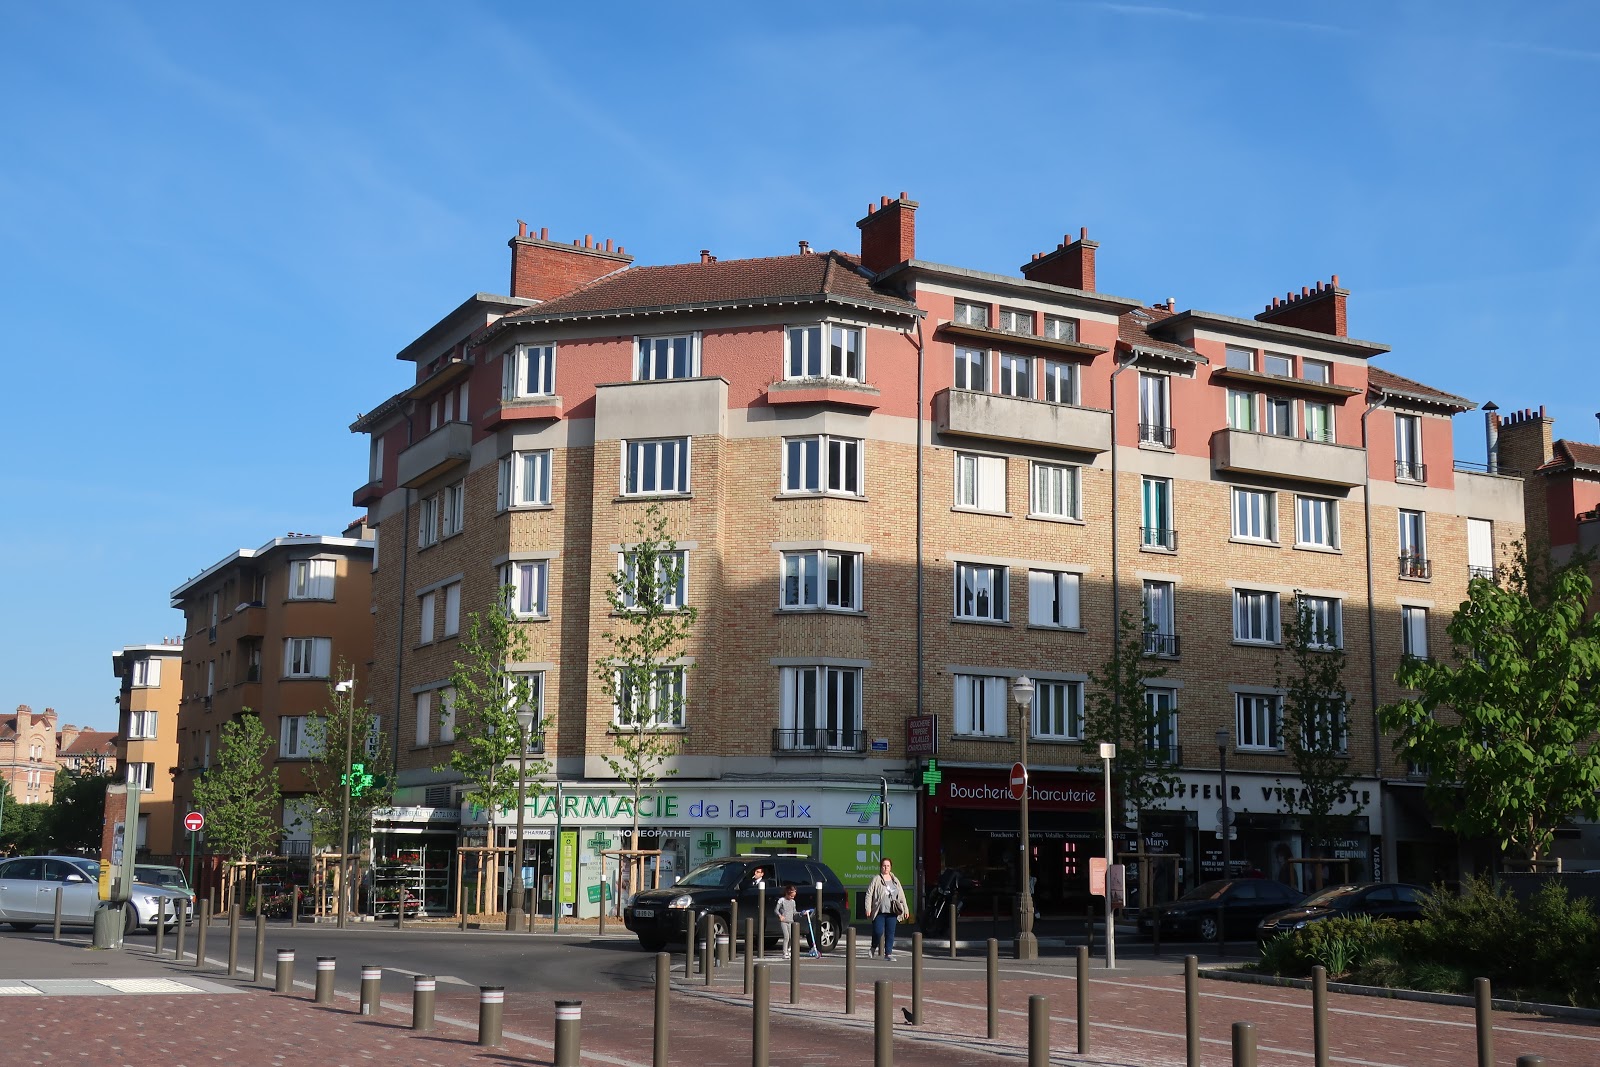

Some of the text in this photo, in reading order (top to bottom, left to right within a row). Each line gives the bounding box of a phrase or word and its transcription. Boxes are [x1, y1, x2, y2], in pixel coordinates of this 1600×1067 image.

[950, 782, 1096, 802] Boucherie Charcuterie
[1262, 786, 1370, 805] VISASTE
[689, 799, 719, 819] de
[729, 799, 749, 819] la
[760, 799, 812, 819] Paix
[735, 830, 749, 838] MISE
[750, 830, 755, 838] A
[756, 830, 772, 838] JOUR
[792, 831, 813, 839] VITALE
[1145, 837, 1169, 849] Marys
[1334, 850, 1367, 859] FEMININ
